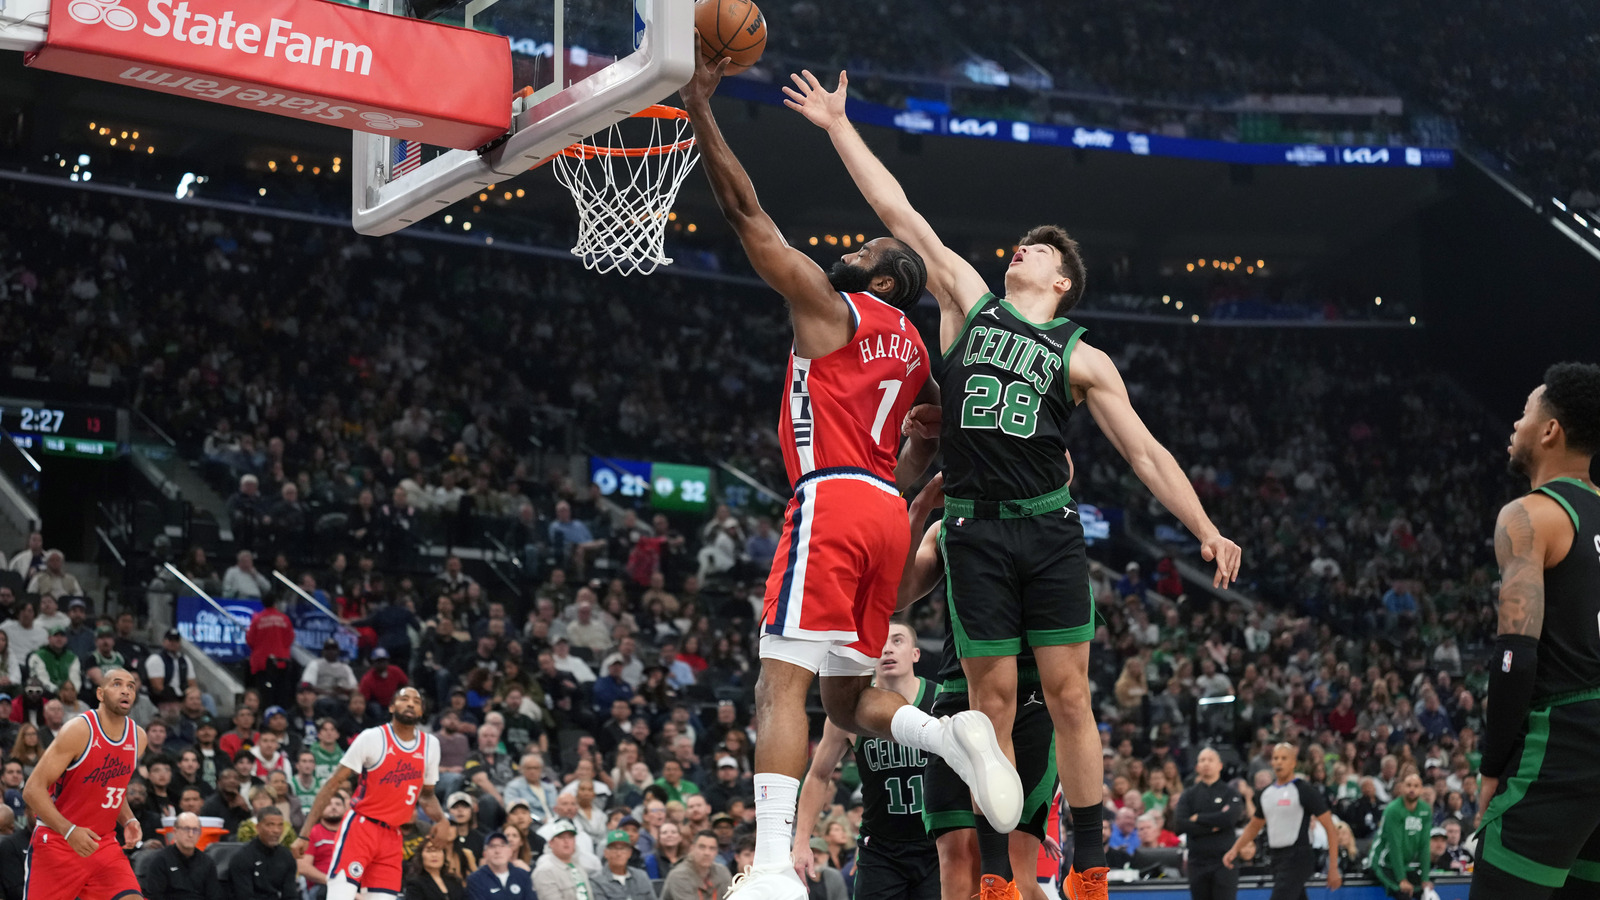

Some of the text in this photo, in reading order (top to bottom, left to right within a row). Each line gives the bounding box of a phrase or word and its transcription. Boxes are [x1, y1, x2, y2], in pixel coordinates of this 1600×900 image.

[962, 325, 1062, 395] CELTICS
[870, 379, 903, 446] 1
[960, 373, 1042, 439] 28
[21, 407, 65, 432] 2:27
[681, 480, 706, 503] 32
[102, 753, 121, 770] Los
[395, 759, 412, 773] Los
[864, 737, 928, 772] CELTIC
[83, 762, 131, 787] Angeles
[379, 766, 423, 788] Angeles
[101, 787, 125, 809] 33
[405, 784, 418, 806] 5
[885, 775, 924, 815] 11
